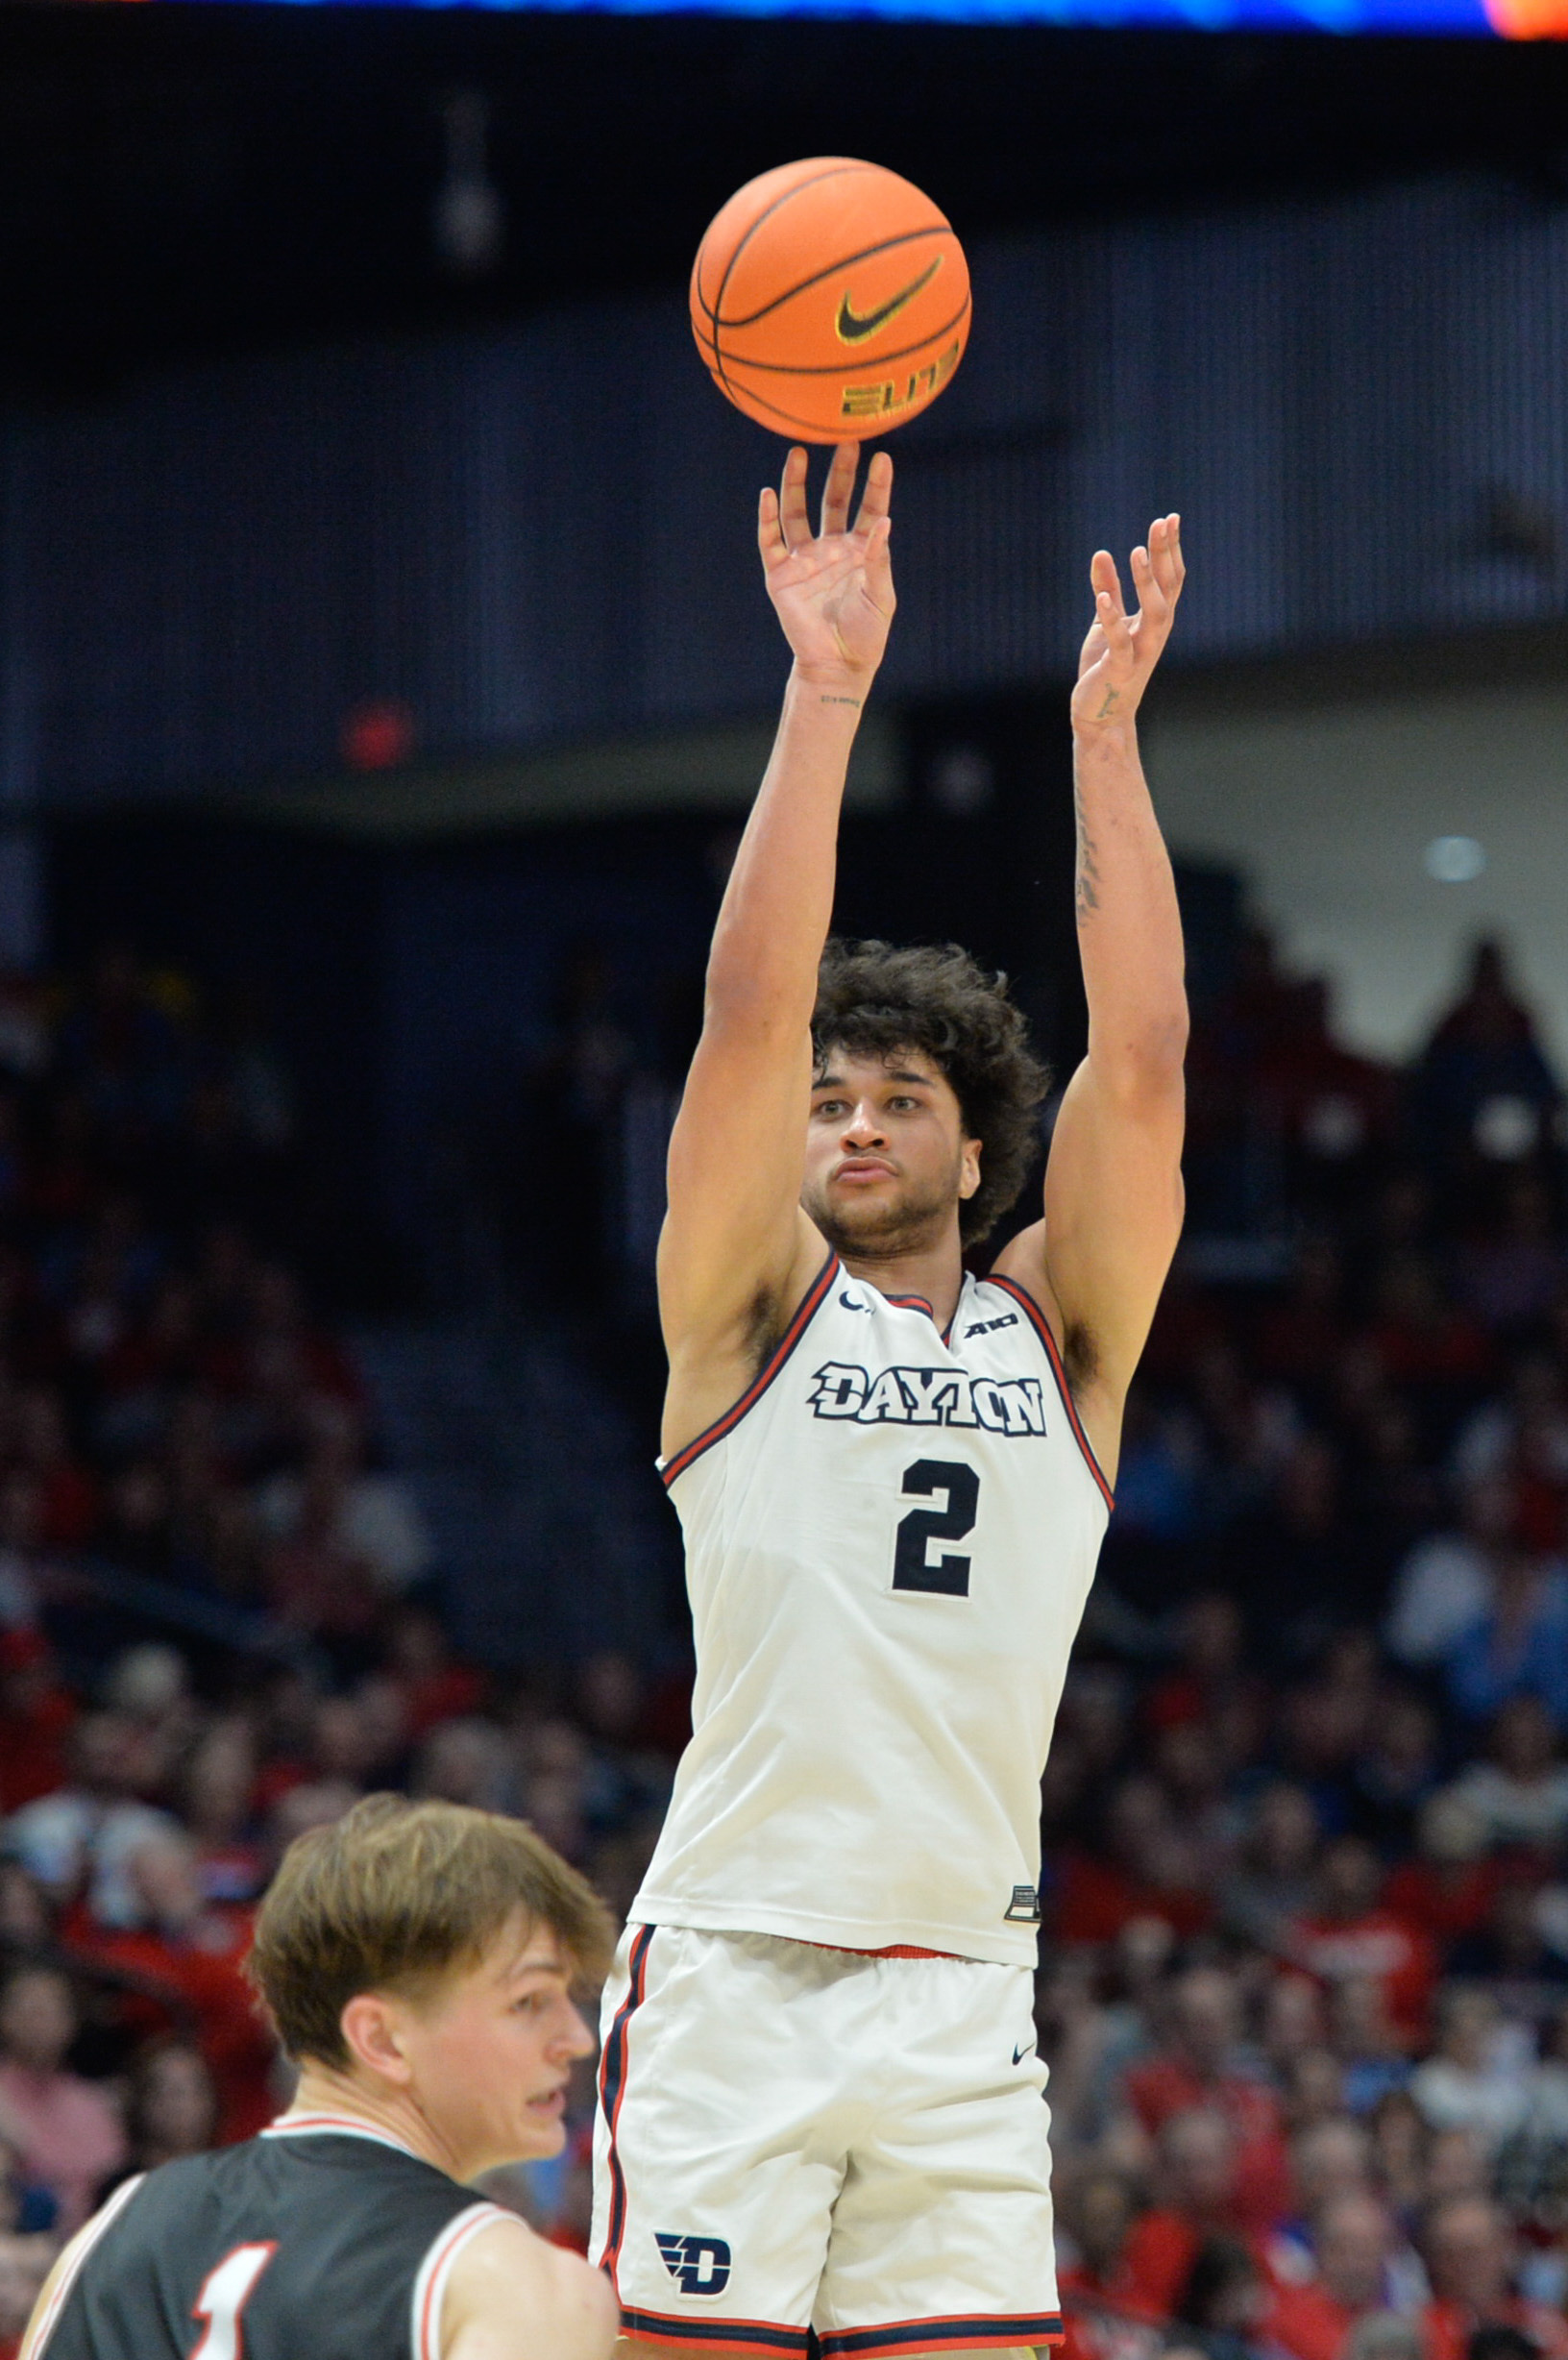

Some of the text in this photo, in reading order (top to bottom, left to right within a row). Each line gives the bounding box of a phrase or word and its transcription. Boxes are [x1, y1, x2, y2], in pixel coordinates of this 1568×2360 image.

[963, 1313, 1018, 1339] A10
[806, 1361, 1047, 1437] DAYTON
[892, 1459, 980, 1597] 2
[189, 2240, 280, 2360] 1
